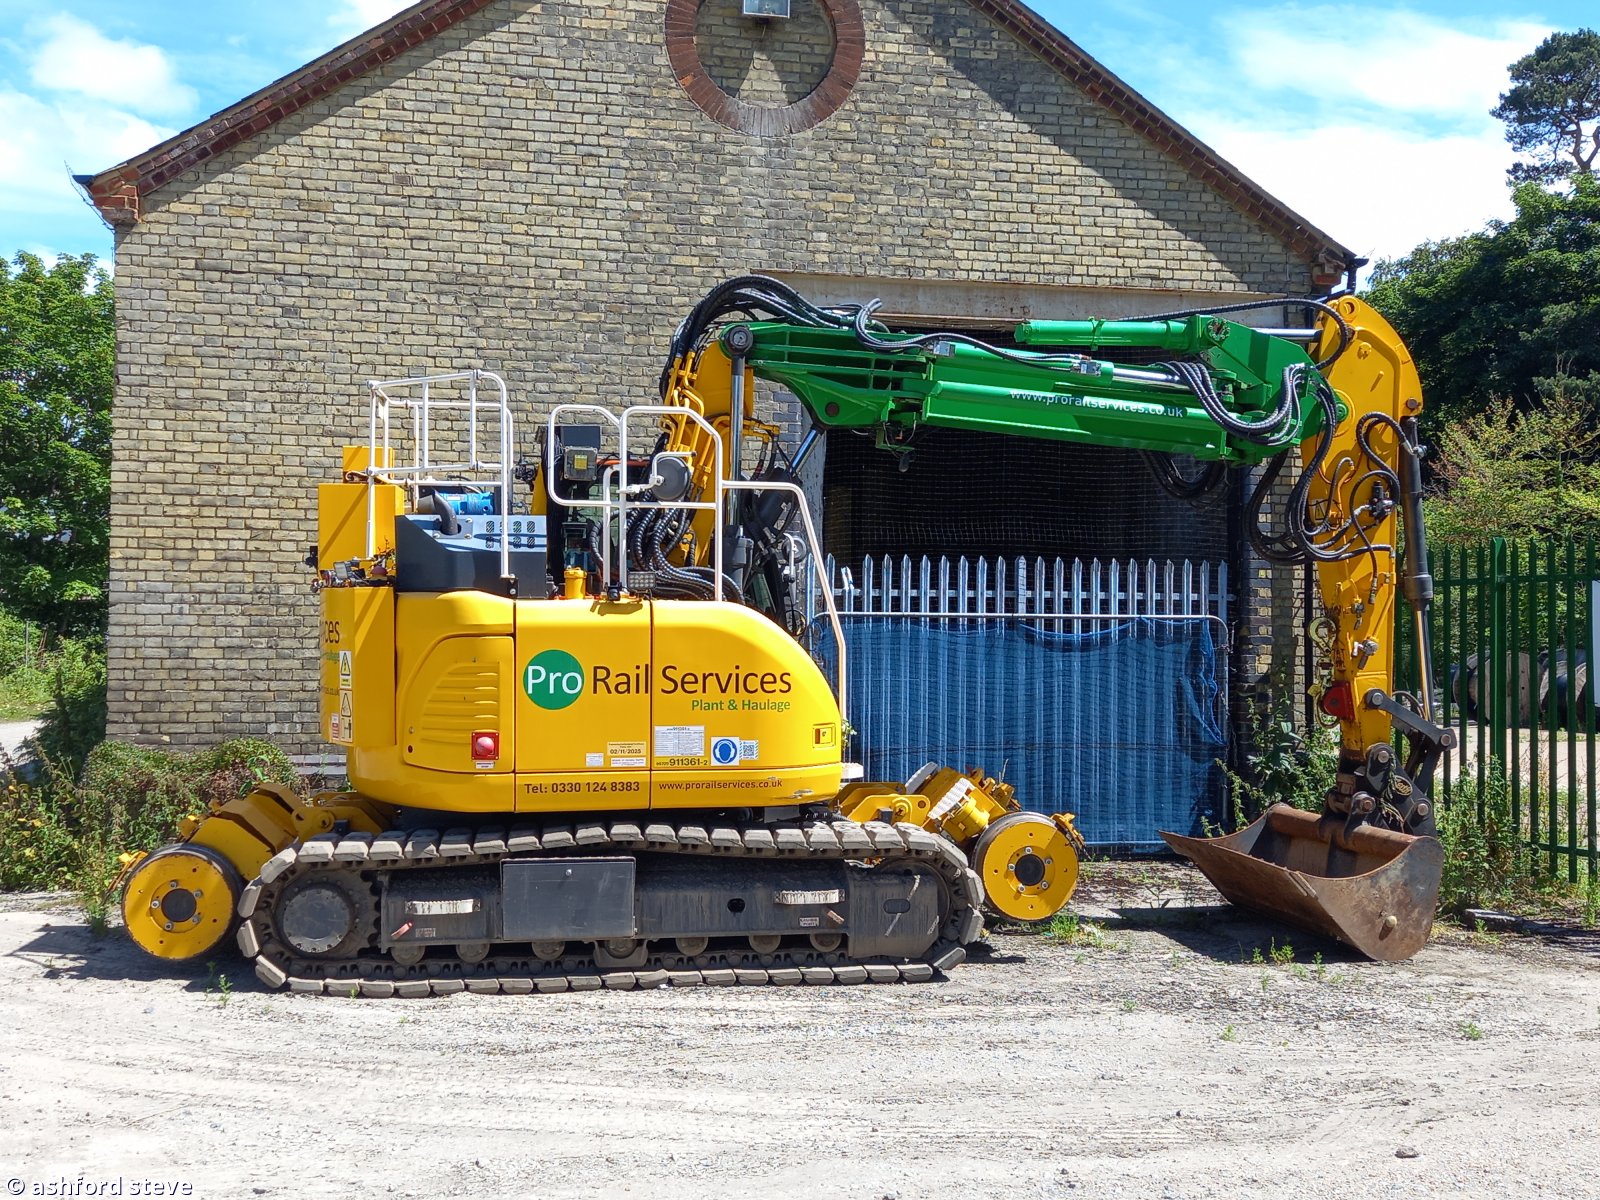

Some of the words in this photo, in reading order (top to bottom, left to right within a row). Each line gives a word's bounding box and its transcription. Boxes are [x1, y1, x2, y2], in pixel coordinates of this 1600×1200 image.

[527, 665, 582, 694] Pro
[592, 665, 651, 694] Rail
[660, 664, 792, 695] Services
[691, 699, 725, 711] Plant
[727, 700, 738, 711] &
[741, 699, 791, 713] Haulage
[524, 783, 548, 794] Tel:
[551, 782, 581, 793] 0330
[585, 782, 607, 793] 124
[610, 781, 640, 792] 8383
[659, 779, 783, 791] www.prorailservices.co.uk
